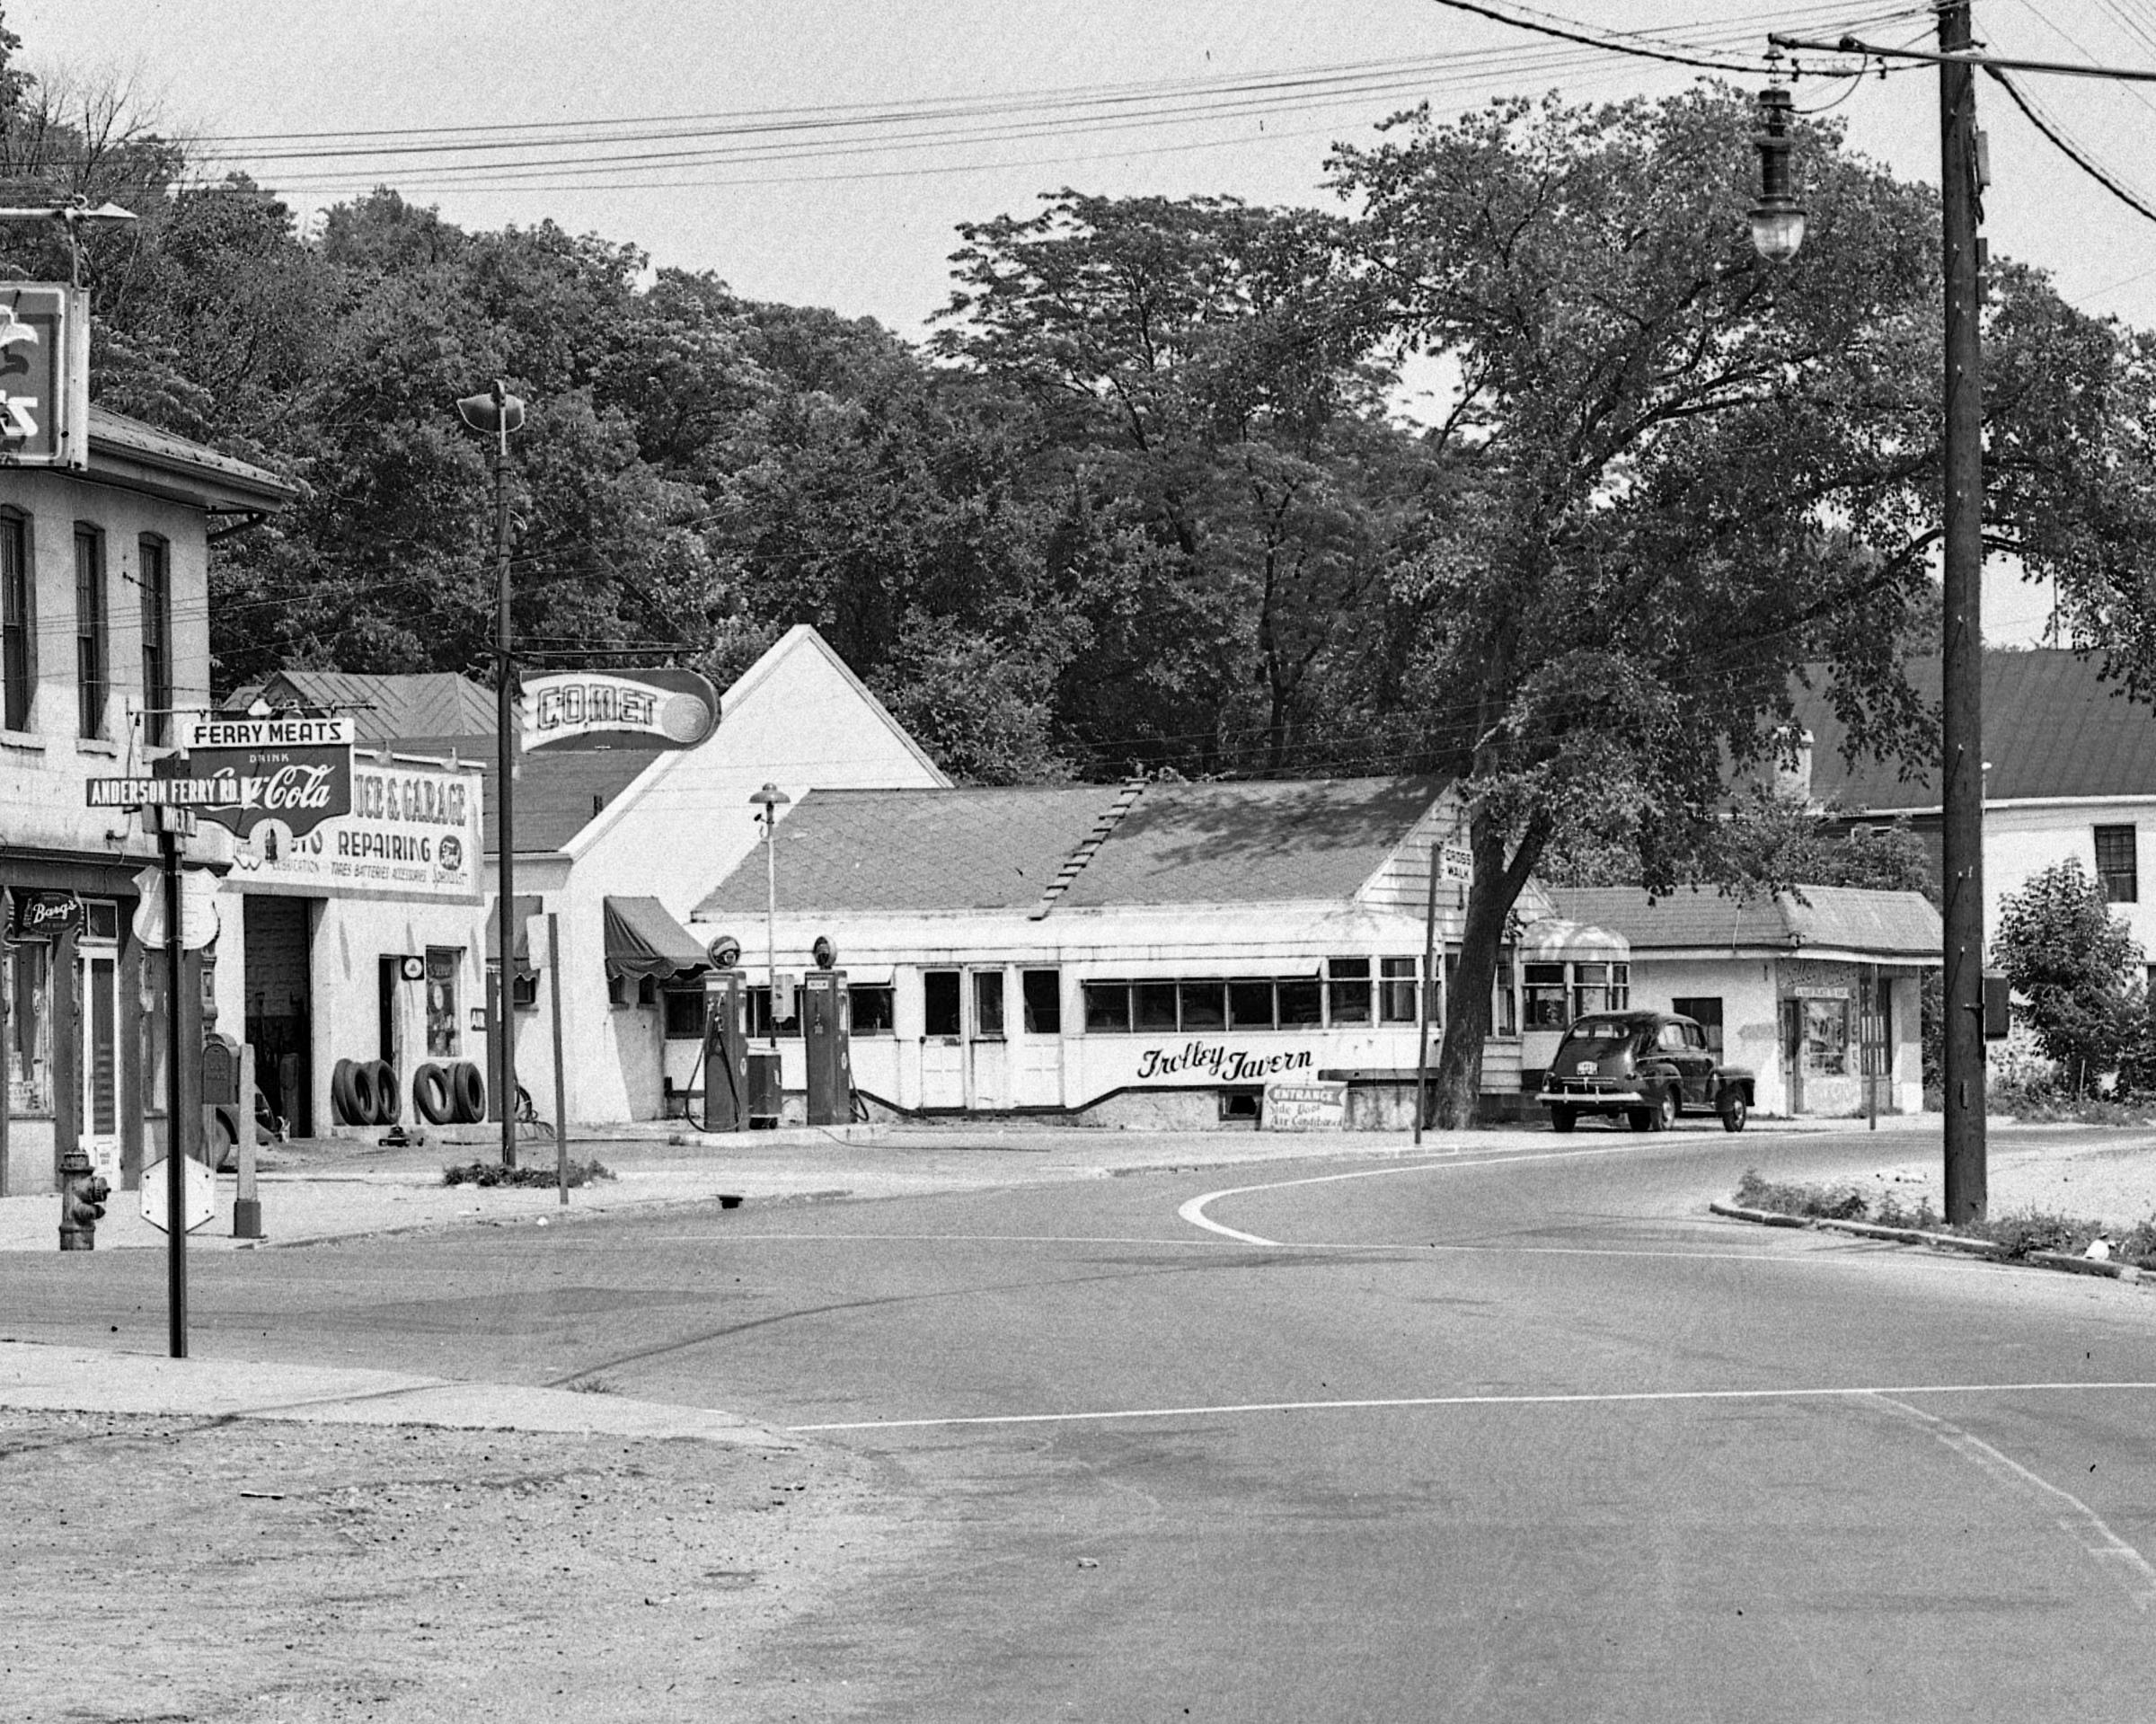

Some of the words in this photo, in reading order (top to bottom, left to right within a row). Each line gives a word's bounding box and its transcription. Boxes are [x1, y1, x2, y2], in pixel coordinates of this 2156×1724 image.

[537, 684, 657, 730] COMET
[194, 724, 262, 744] FERRY
[270, 722, 341, 742] MEATS
[249, 754, 289, 763] DRINK
[91, 780, 167, 804] ANDERSON
[171, 779, 216, 803] FERRY
[402, 777, 466, 827] GARAGE
[338, 831, 431, 862] REPAIRING
[1446, 849, 1471, 865] CROSS
[1448, 867, 1469, 880] WALK
[1137, 1040, 1226, 1078] Trolley
[1222, 1050, 1313, 1081] Tavern
[1274, 1089, 1333, 1101] ENTRANCE
